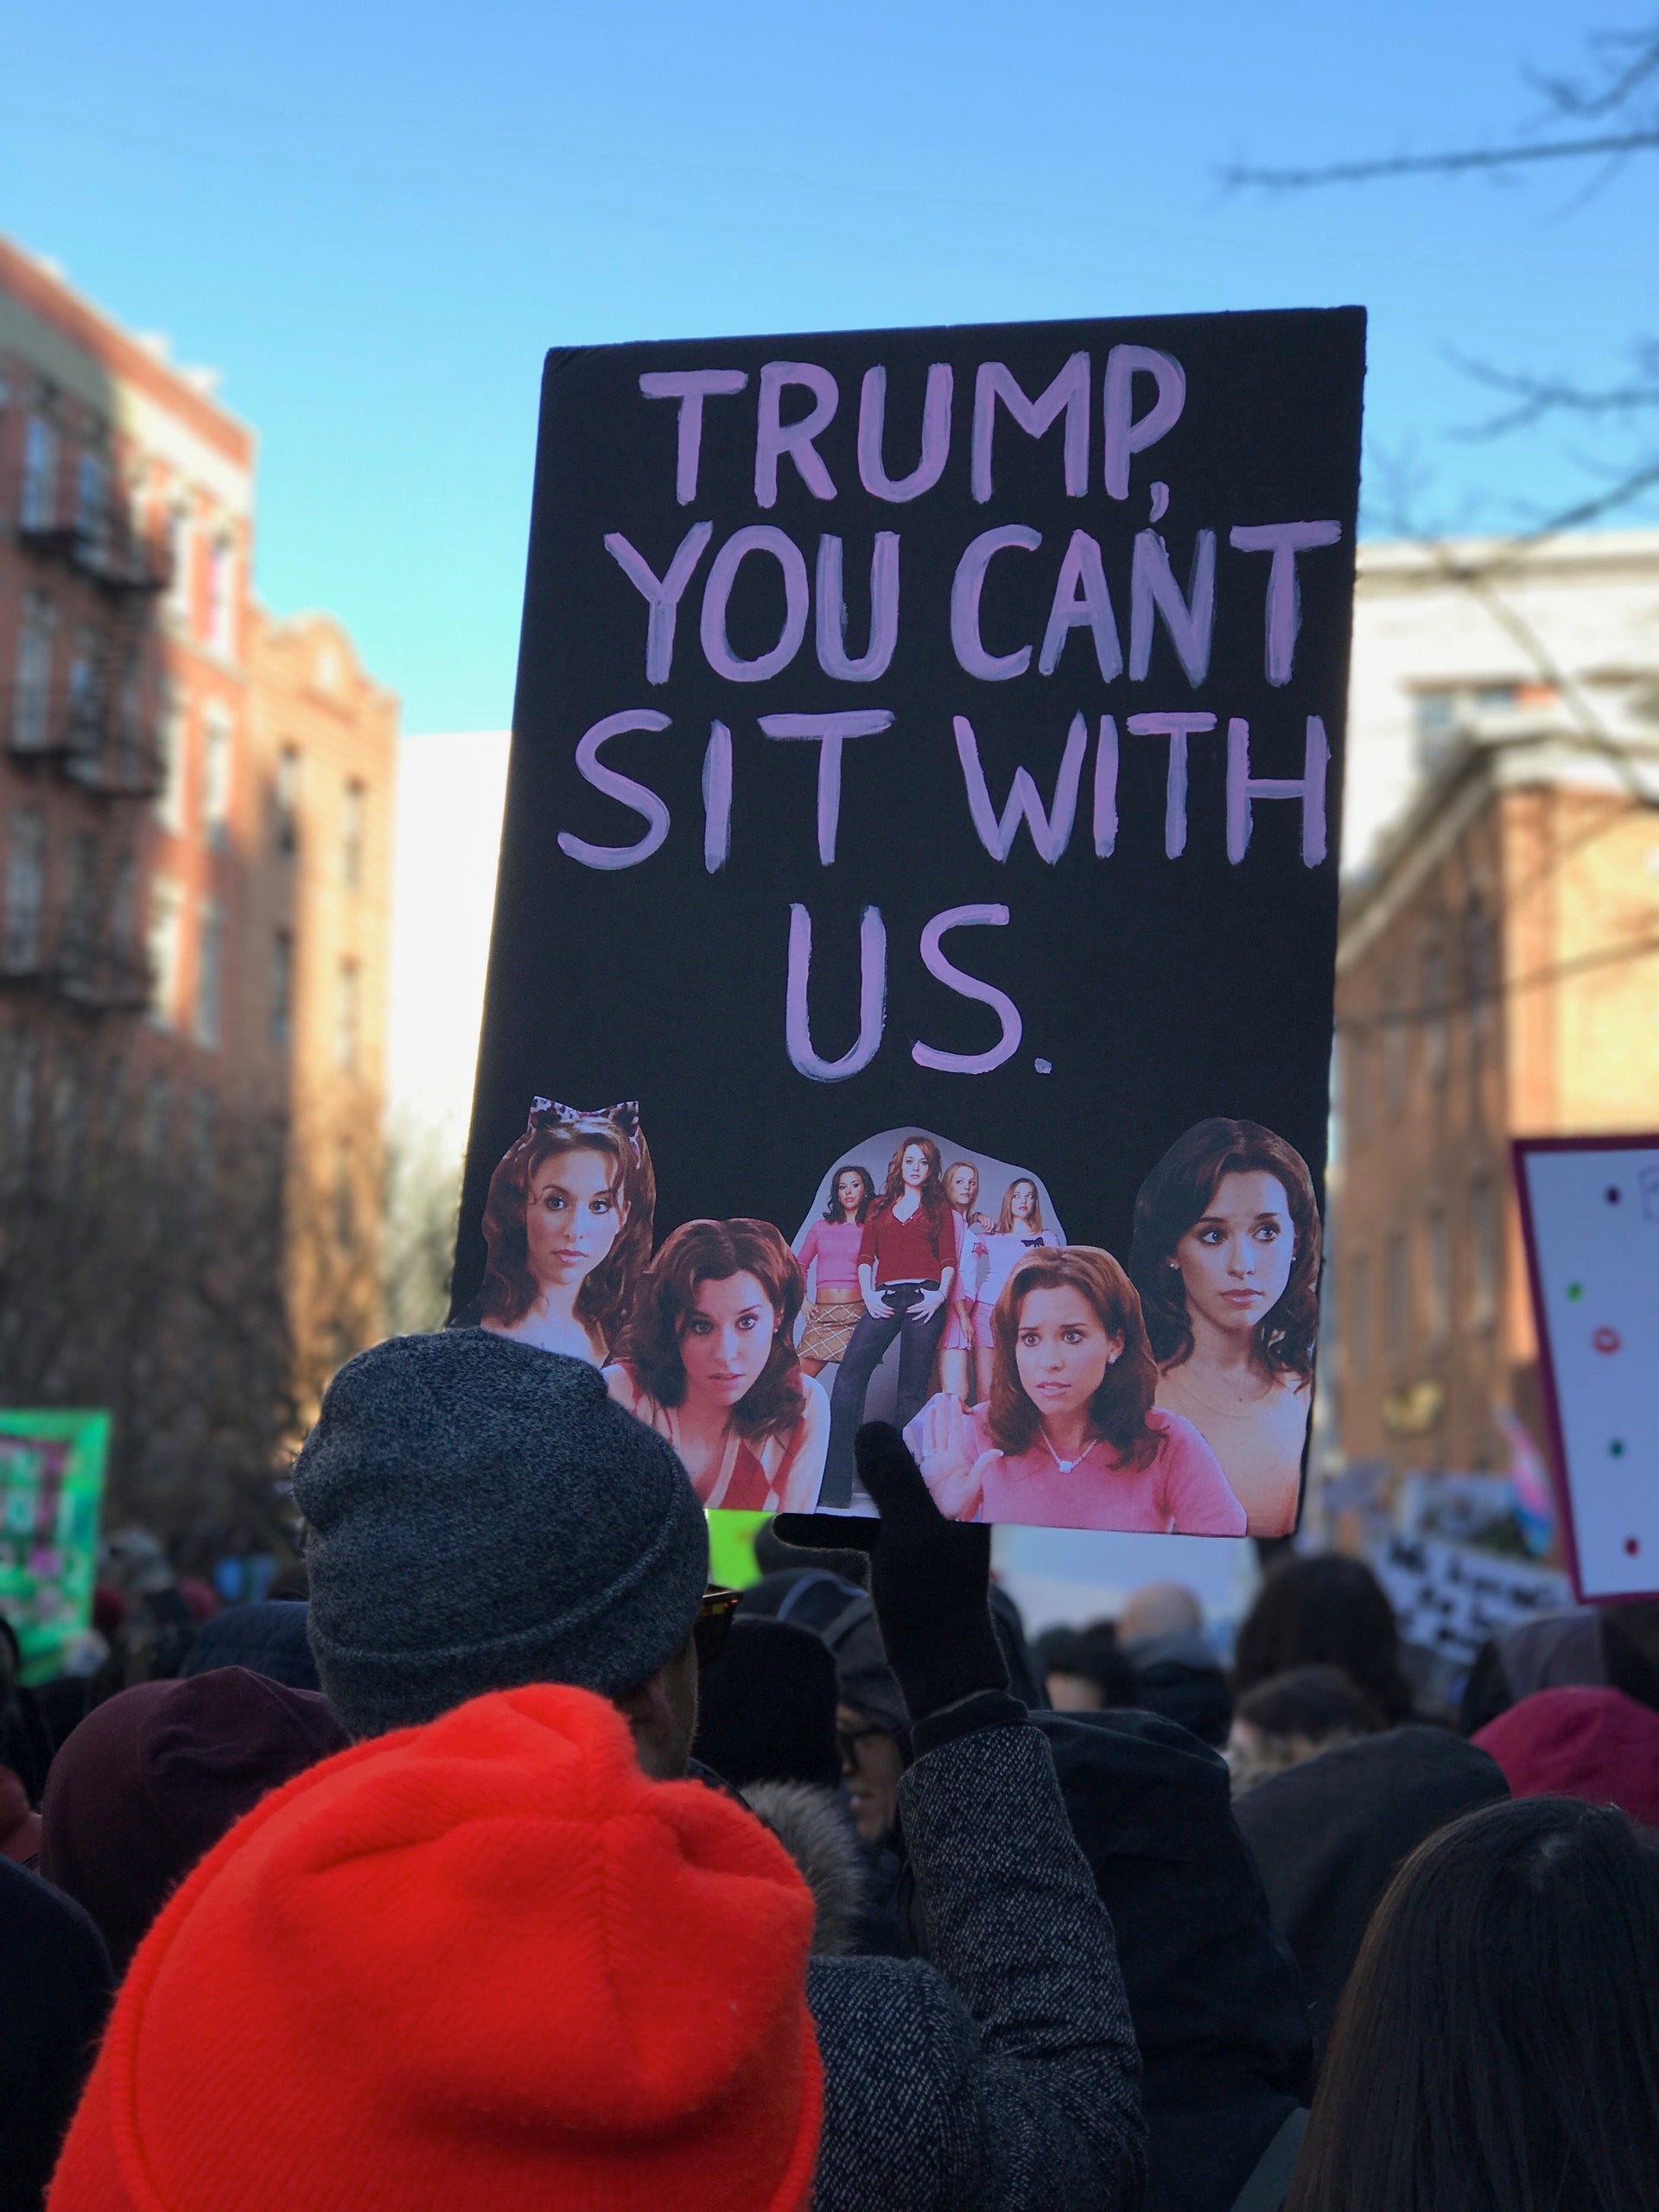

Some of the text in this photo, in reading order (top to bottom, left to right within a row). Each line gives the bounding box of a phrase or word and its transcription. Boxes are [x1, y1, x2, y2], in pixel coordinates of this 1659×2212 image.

[638, 344, 1186, 524] TRUMP,
[604, 520, 901, 687] YOU
[557, 709, 1332, 874] SIT WITH
[785, 902, 1054, 1084] US.
